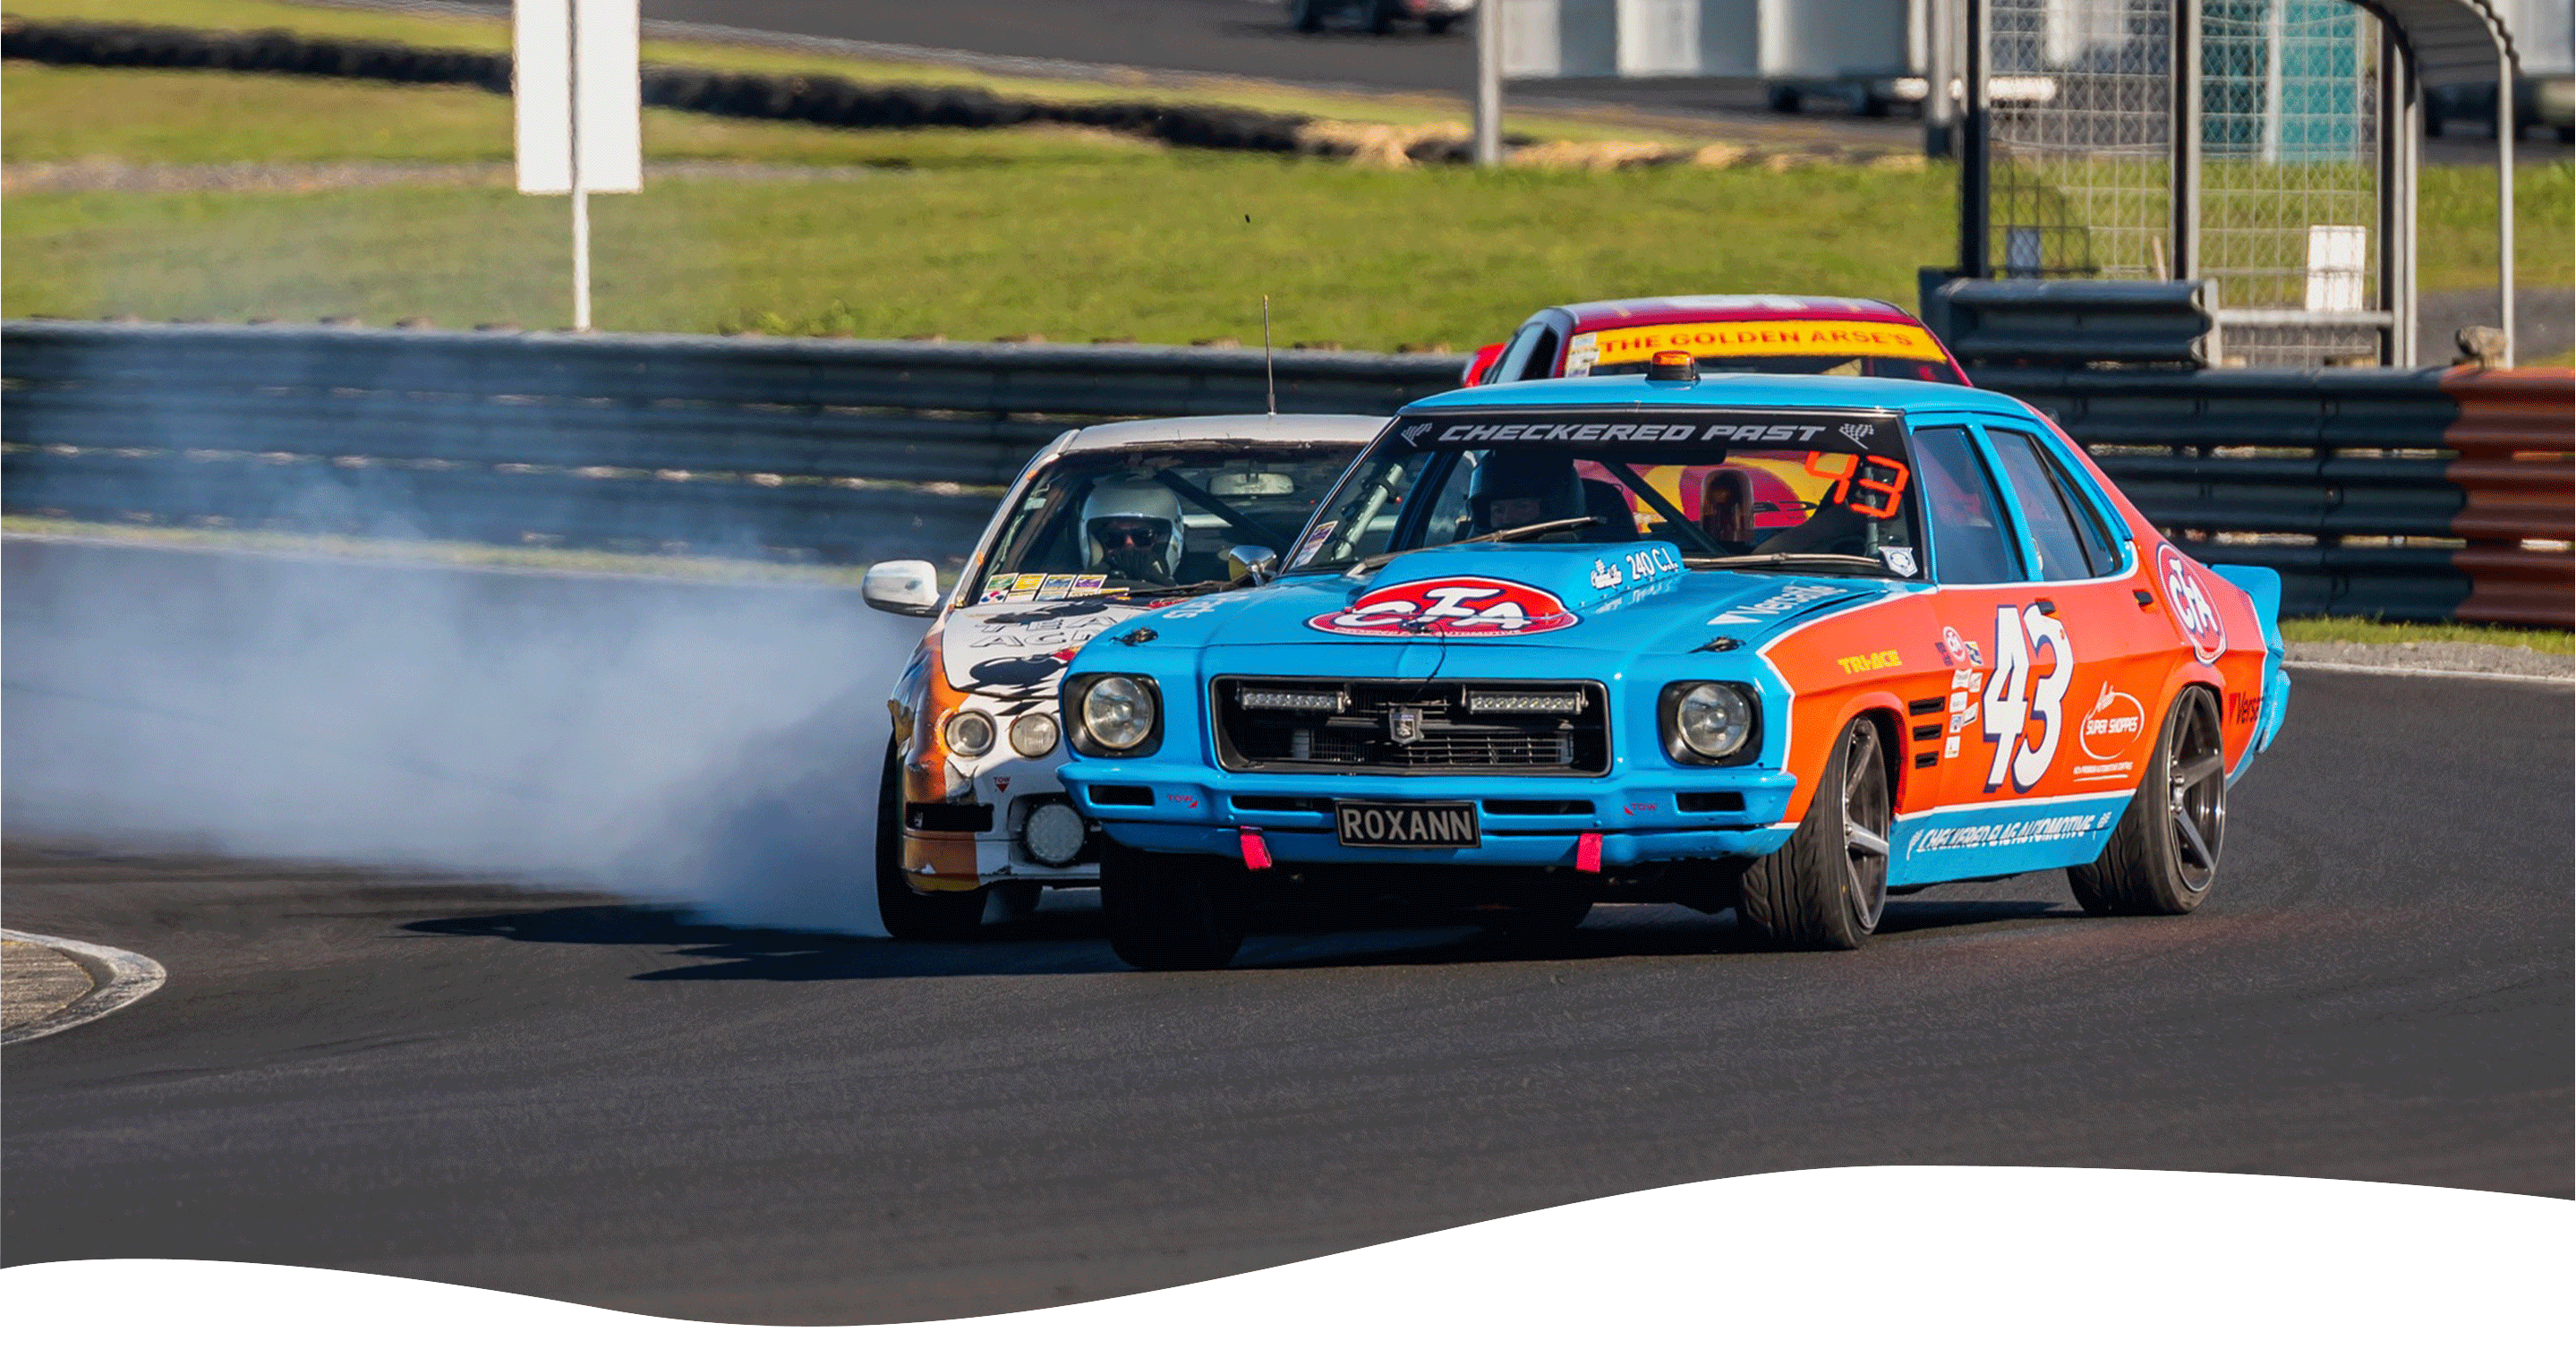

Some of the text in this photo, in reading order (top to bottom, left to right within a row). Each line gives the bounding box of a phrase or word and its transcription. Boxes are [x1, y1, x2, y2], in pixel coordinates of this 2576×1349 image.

[1599, 329, 1915, 354] THE GOLDEN ARSE'S
[1437, 424, 1827, 442] CHECKERED PAST
[1804, 450, 1911, 519] 43
[1625, 551, 1656, 581] 240
[1983, 602, 2075, 794] 43
[2086, 719, 2108, 735] SUPER
[1631, 803, 1656, 811] TOW
[1342, 808, 1473, 841] ROXANN
